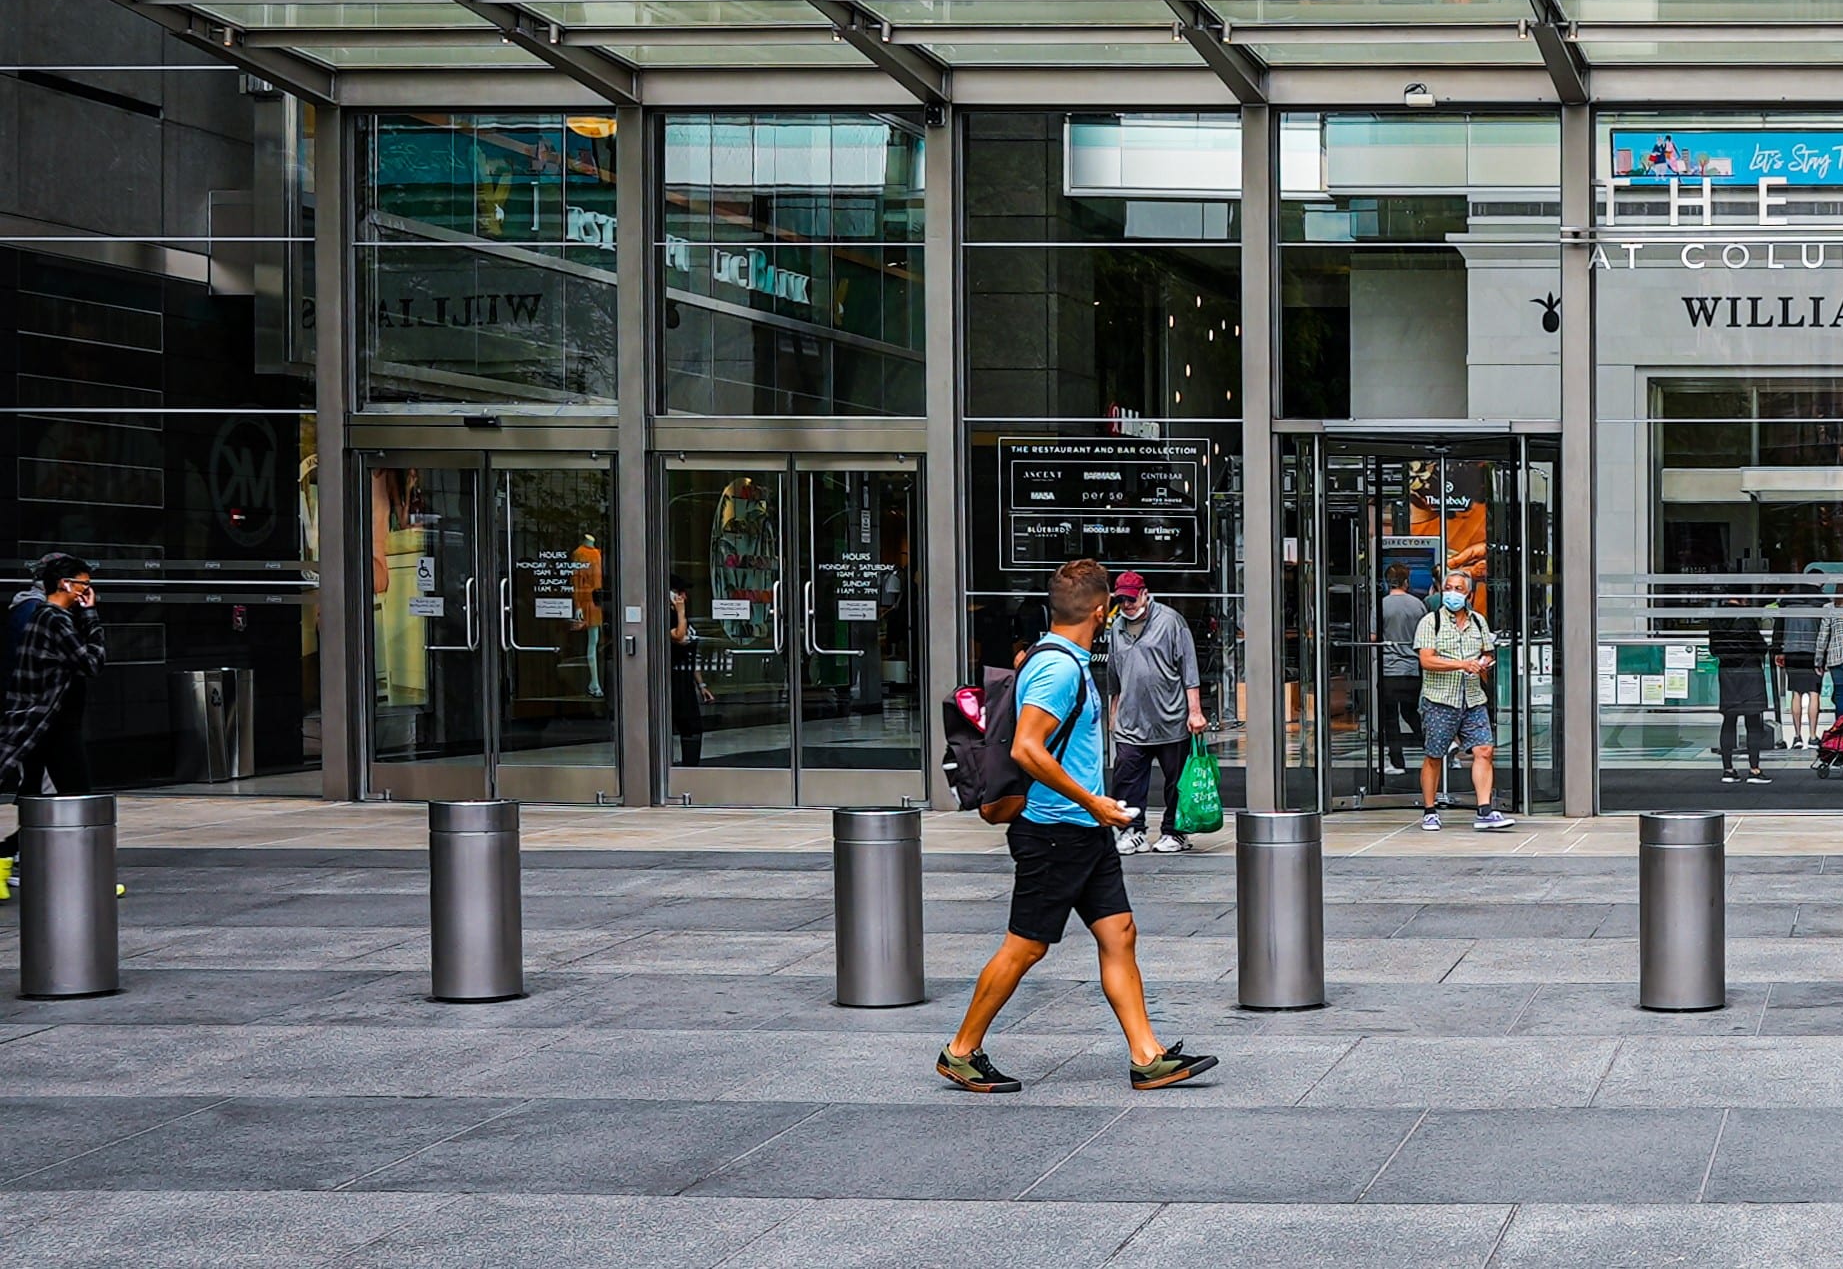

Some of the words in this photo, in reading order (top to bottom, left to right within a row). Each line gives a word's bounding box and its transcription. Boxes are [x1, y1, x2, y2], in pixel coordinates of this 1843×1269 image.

[1749, 143, 1785, 173] Let's
[1788, 143, 1831, 179] Stay
[1592, 177, 1788, 227] THE
[1587, 242, 1643, 270] AT
[1011, 445, 1028, 453] THE
[1032, 446, 1091, 454] RESTAURANT
[1094, 446, 1114, 454] AND
[1139, 447, 1197, 455] COLLECTION
[1023, 470, 1062, 479] ASCENT
[1031, 491, 1055, 500] MASA
[1082, 491, 1103, 501] per
[1109, 492, 1123, 500] se
[1382, 538, 1431, 546] DIRECTORY
[539, 551, 567, 559] HOURS
[842, 553, 871, 561] HOURS
